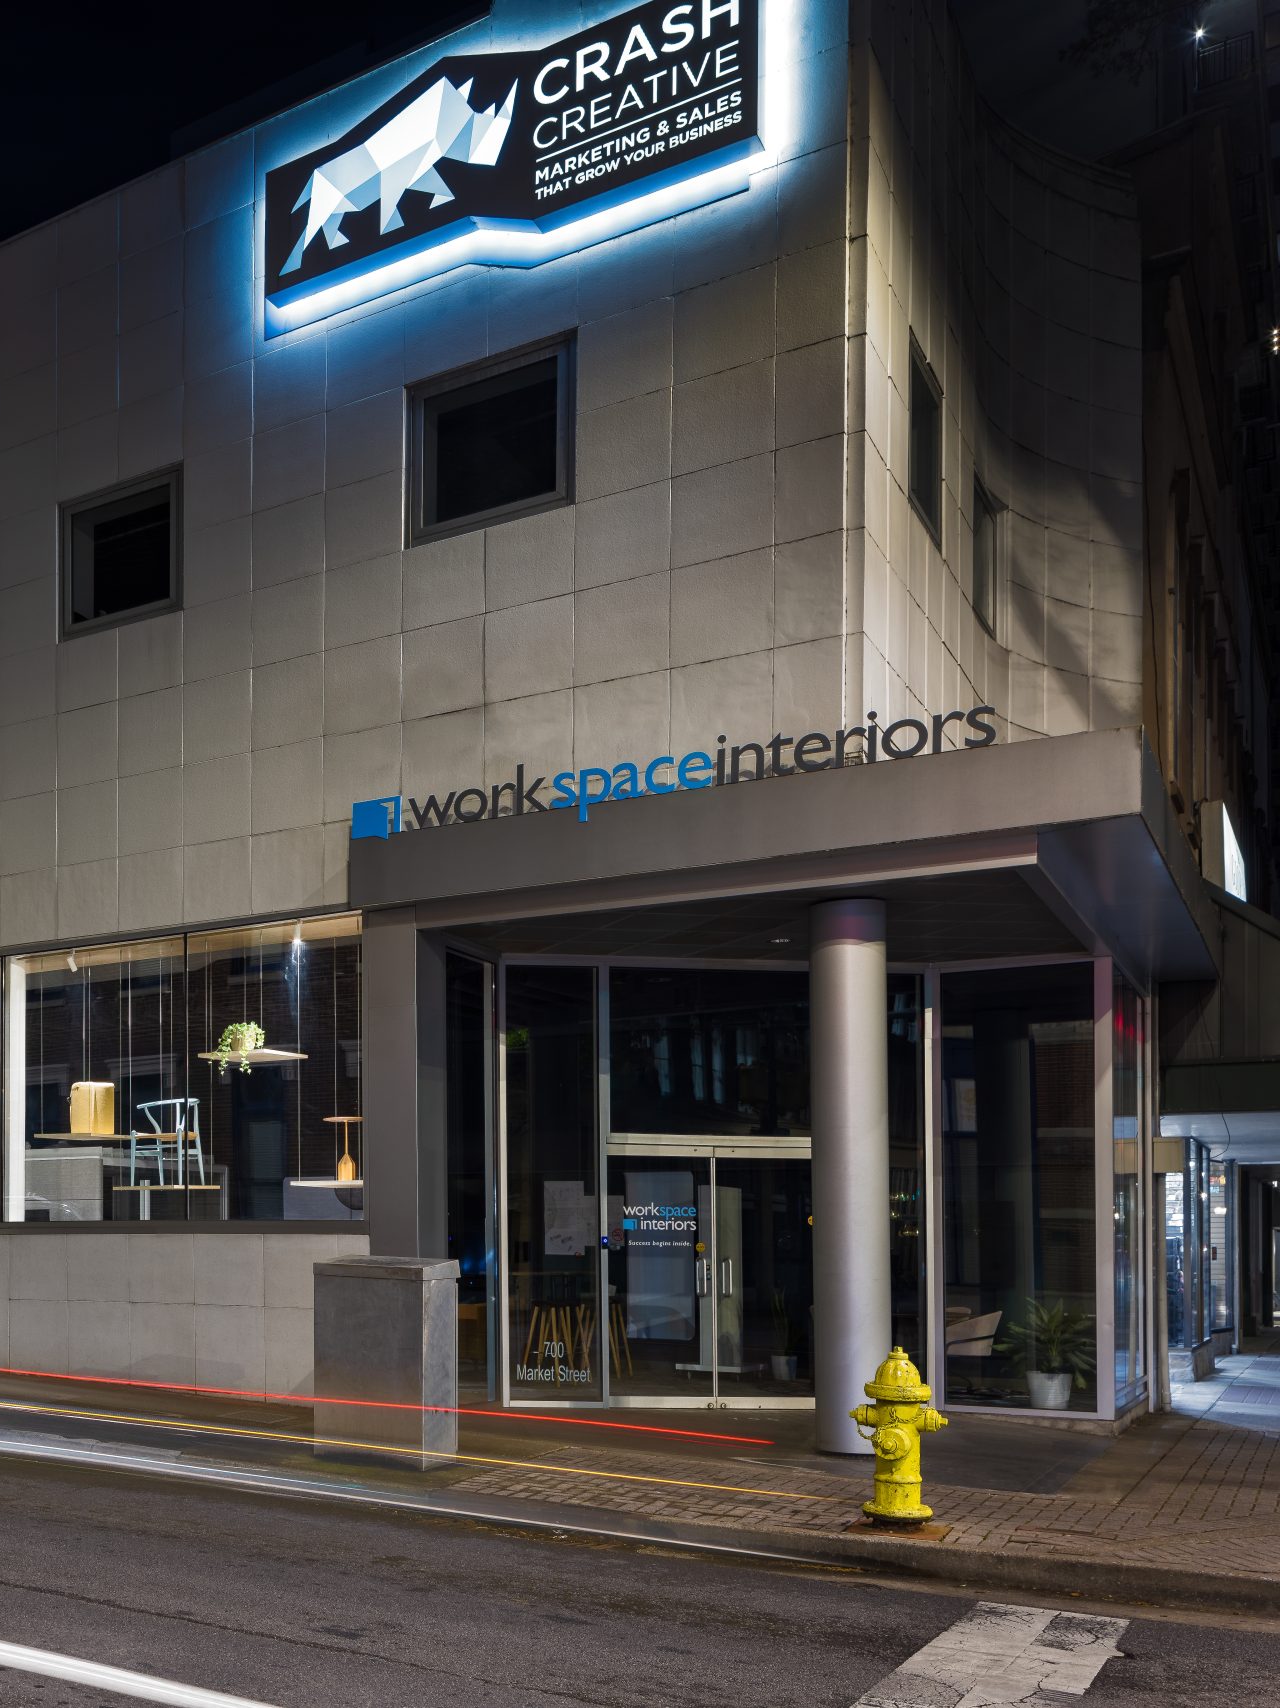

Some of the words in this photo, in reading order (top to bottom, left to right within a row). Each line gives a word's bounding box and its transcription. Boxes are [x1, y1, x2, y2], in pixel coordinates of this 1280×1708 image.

[533, 0, 740, 104] CRASH
[532, 40, 740, 149] CREATIVE
[535, 127, 650, 185] MARKETING
[656, 120, 670, 137] &
[676, 91, 742, 129] SALES
[535, 177, 572, 200] THAT
[575, 158, 620, 185] GROW
[624, 141, 666, 168] YOUR
[669, 111, 742, 149] BUSINESS
[623, 1202, 696, 1220] workspace
[640, 1217, 697, 1231] interiors
[516, 1364, 555, 1382] Market
[558, 1365, 591, 1383] Street
[543, 1341, 565, 1358] 700
